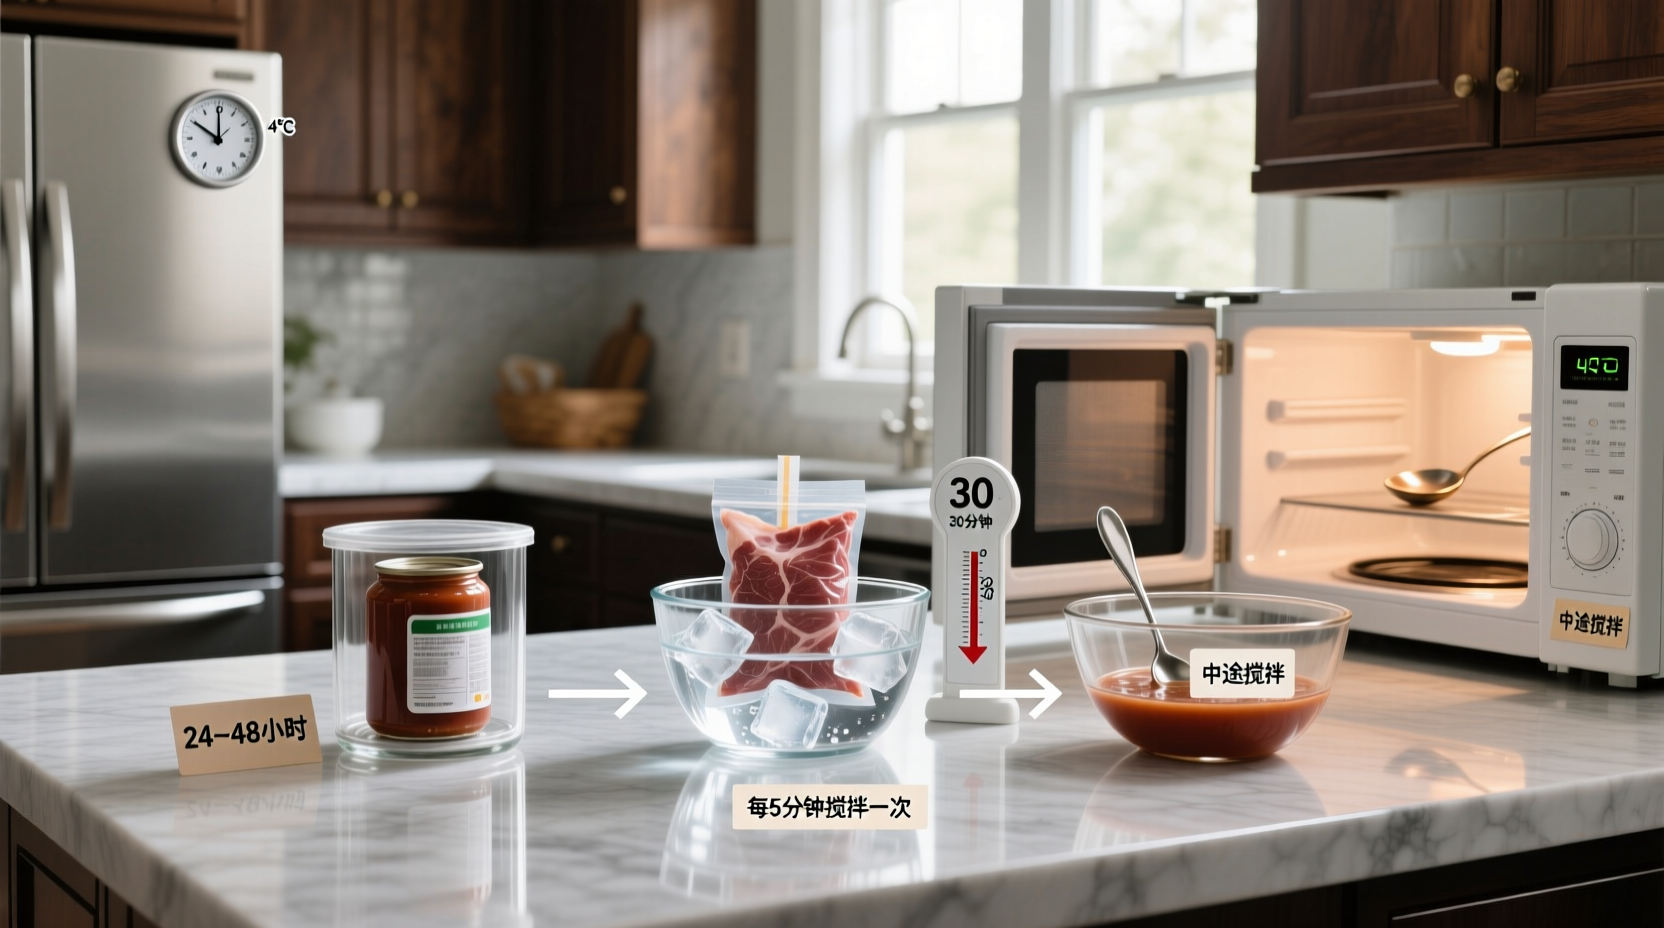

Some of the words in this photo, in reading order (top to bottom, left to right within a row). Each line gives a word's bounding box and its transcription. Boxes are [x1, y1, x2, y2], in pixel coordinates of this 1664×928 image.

[949, 476, 994, 509] 30
[949, 513, 993, 530] 30分钟
[747, 795, 912, 820] 每5分钟搅拌一次
